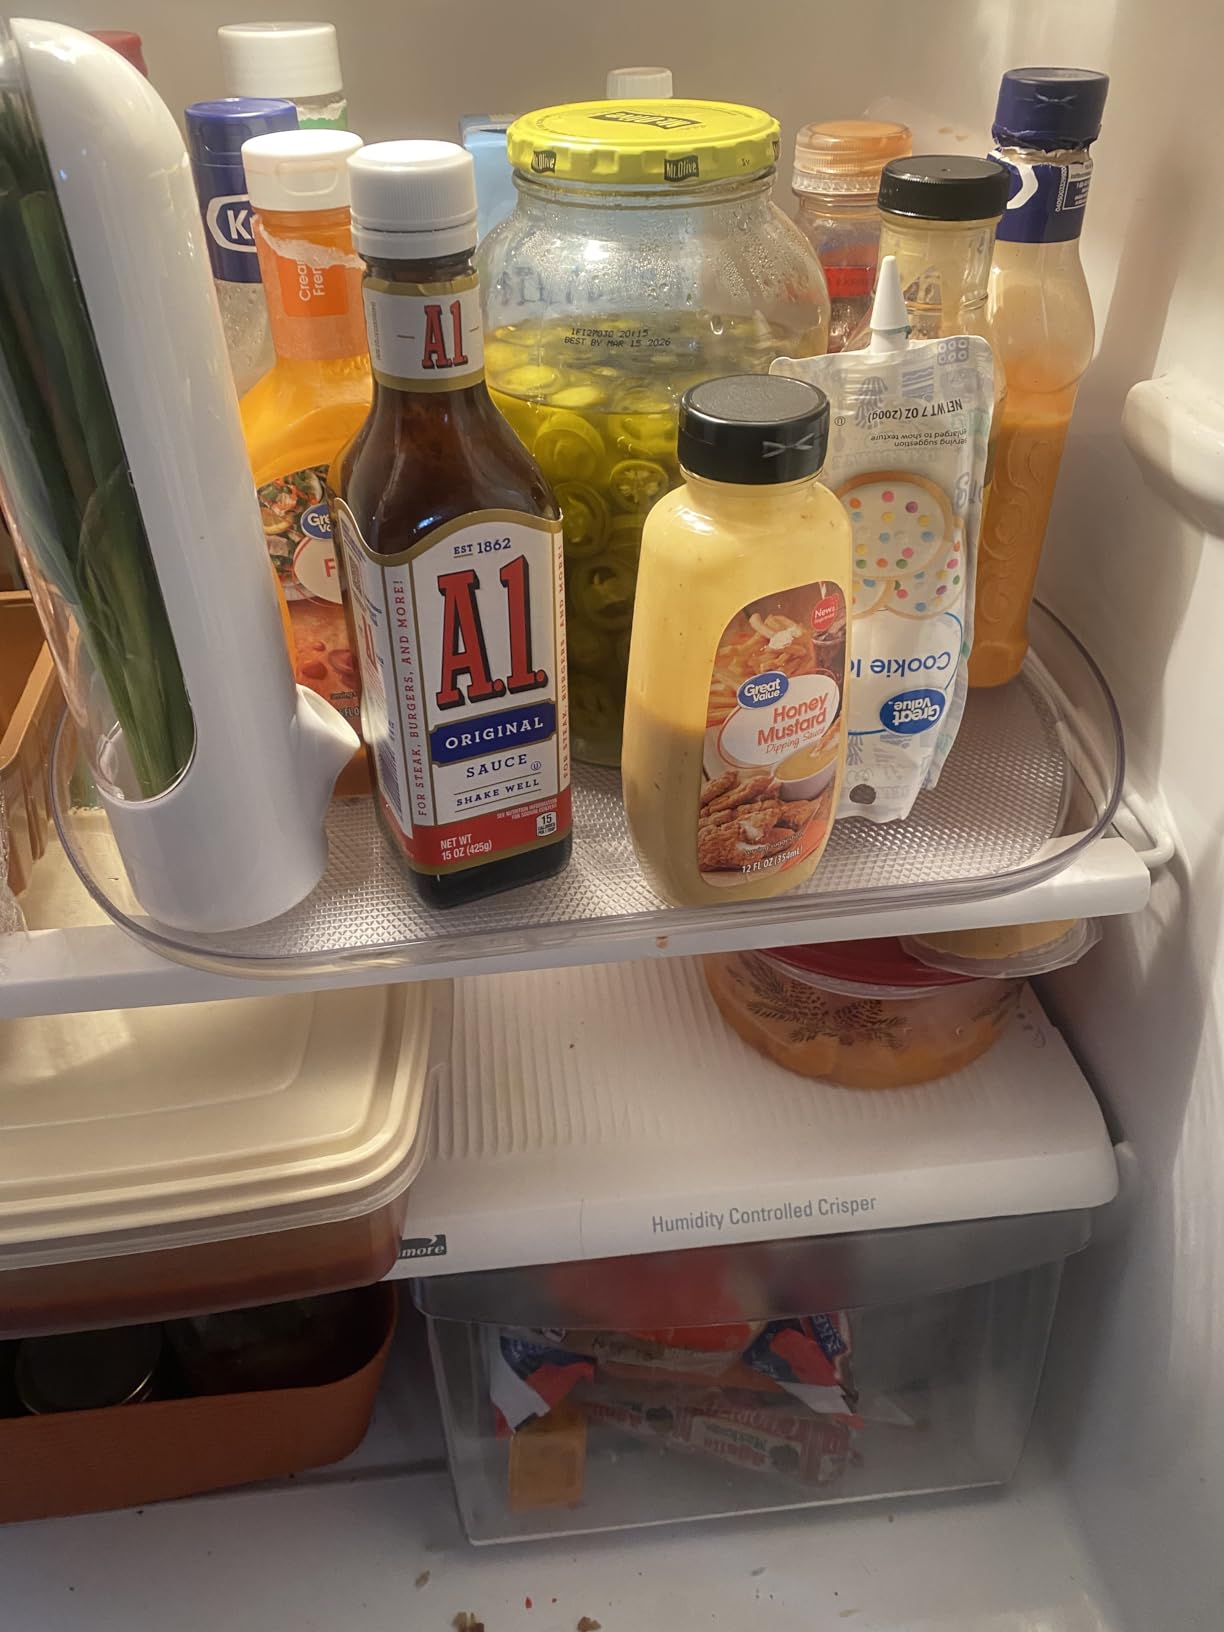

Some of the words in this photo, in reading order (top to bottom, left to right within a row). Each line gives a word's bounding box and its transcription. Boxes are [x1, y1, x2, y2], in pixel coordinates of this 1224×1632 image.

[226, 209, 255, 240] K
[591, 338, 602, 347] BY
[606, 339, 624, 347] MAR
[631, 339, 642, 348] 15
[648, 338, 671, 347] 2026
[868, 408, 903, 423] (200g)
[905, 408, 919, 419] OZ
[921, 406, 928, 417] 7
[930, 402, 946, 416] WT
[946, 399, 963, 413] NET
[870, 433, 899, 441] texture
[894, 439, 938, 447] suggestion
[453, 544, 473, 555] EST
[476, 537, 512, 554] 1862
[393, 580, 408, 628] MORE!
[400, 635, 412, 665] AND
[851, 658, 861, 678] I
[870, 651, 951, 678] Cookie
[744, 678, 781, 697] Great
[752, 689, 780, 703] Value
[403, 671, 419, 738] BURGERS,
[773, 692, 828, 724] Honey
[893, 697, 932, 711] Value
[892, 705, 940, 726] Great
[445, 716, 544, 749] ORIGINAL
[757, 709, 827, 746] Mustard
[766, 737, 800, 753] Dipping
[411, 744, 424, 788] STEAK,
[466, 753, 528, 778] SAUCE
[456, 788, 500, 807] SHAKE
[505, 778, 540, 793] WELL
[417, 793, 427, 816] FOR
[541, 813, 552, 825] 15
[440, 836, 457, 849] NET
[459, 833, 472, 845] WT
[441, 850, 452, 861] 15
[453, 846, 465, 858] OZ
[466, 840, 493, 856] (425g)
[741, 864, 752, 873] 12
[753, 861, 761, 871] FL
[763, 857, 774, 868] OZ
[652, 1212, 724, 1234] Humidity
[729, 1200, 813, 1226] Controlled
[818, 1196, 877, 1217] Crisper
